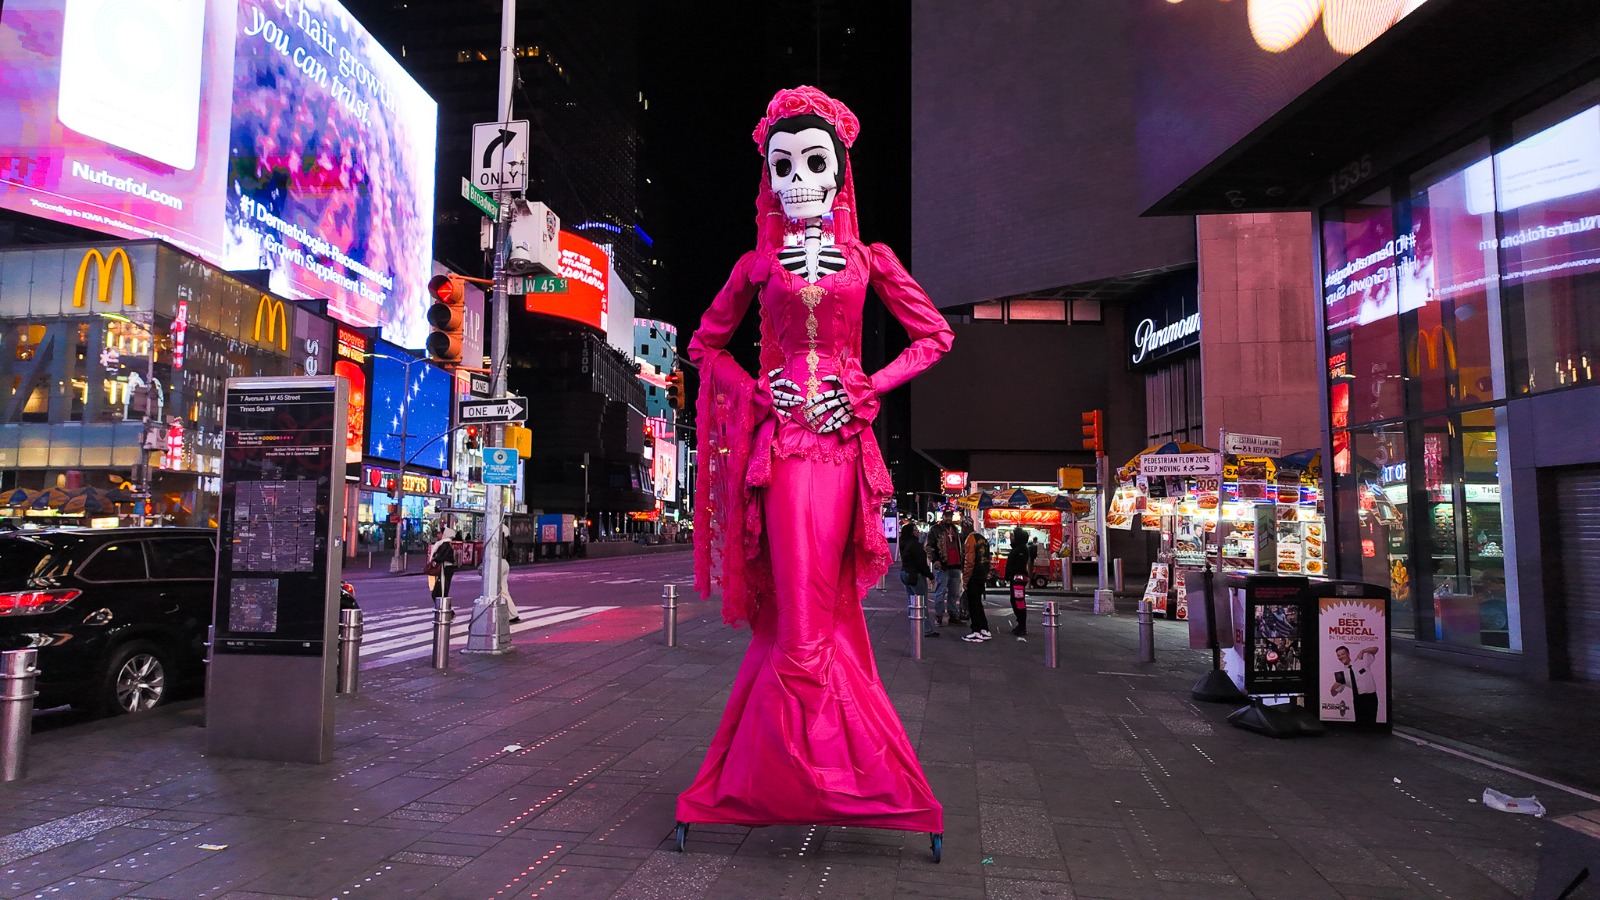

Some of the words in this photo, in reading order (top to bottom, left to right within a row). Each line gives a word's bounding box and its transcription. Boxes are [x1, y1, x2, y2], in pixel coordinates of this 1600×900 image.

[244, 6, 290, 56] you
[293, 47, 328, 88] can
[330, 74, 372, 127] trust.
[297, 4, 336, 57] hair
[339, 46, 395, 113] growth
[72, 160, 183, 210] Nutrafol.com
[480, 171, 519, 185] ONLY
[470, 186, 498, 219] Broadway
[240, 194, 255, 217] #1
[257, 202, 392, 291] Dermatologist-Recommended
[265, 234, 305, 267] Growth
[306, 254, 359, 293] Supplement
[579, 255, 591, 265] THE
[525, 280, 536, 292] W
[541, 280, 555, 292] 45
[560, 280, 568, 289] St
[464, 306, 480, 342] GAP
[1132, 312, 1201, 364] Paramoun
[476, 381, 486, 392] ONE
[468, 407, 488, 416] ONE
[497, 405, 517, 415] WAY
[1264, 447, 1280, 455] MOVING
[1144, 465, 1158, 473] KEEP
[1159, 465, 1180, 473] MOVING
[366, 468, 372, 486] I
[430, 478, 434, 493] I
[440, 480, 453, 495] NY
[1329, 626, 1375, 636] MUSICAL
[1338, 618, 1365, 626] BEST
